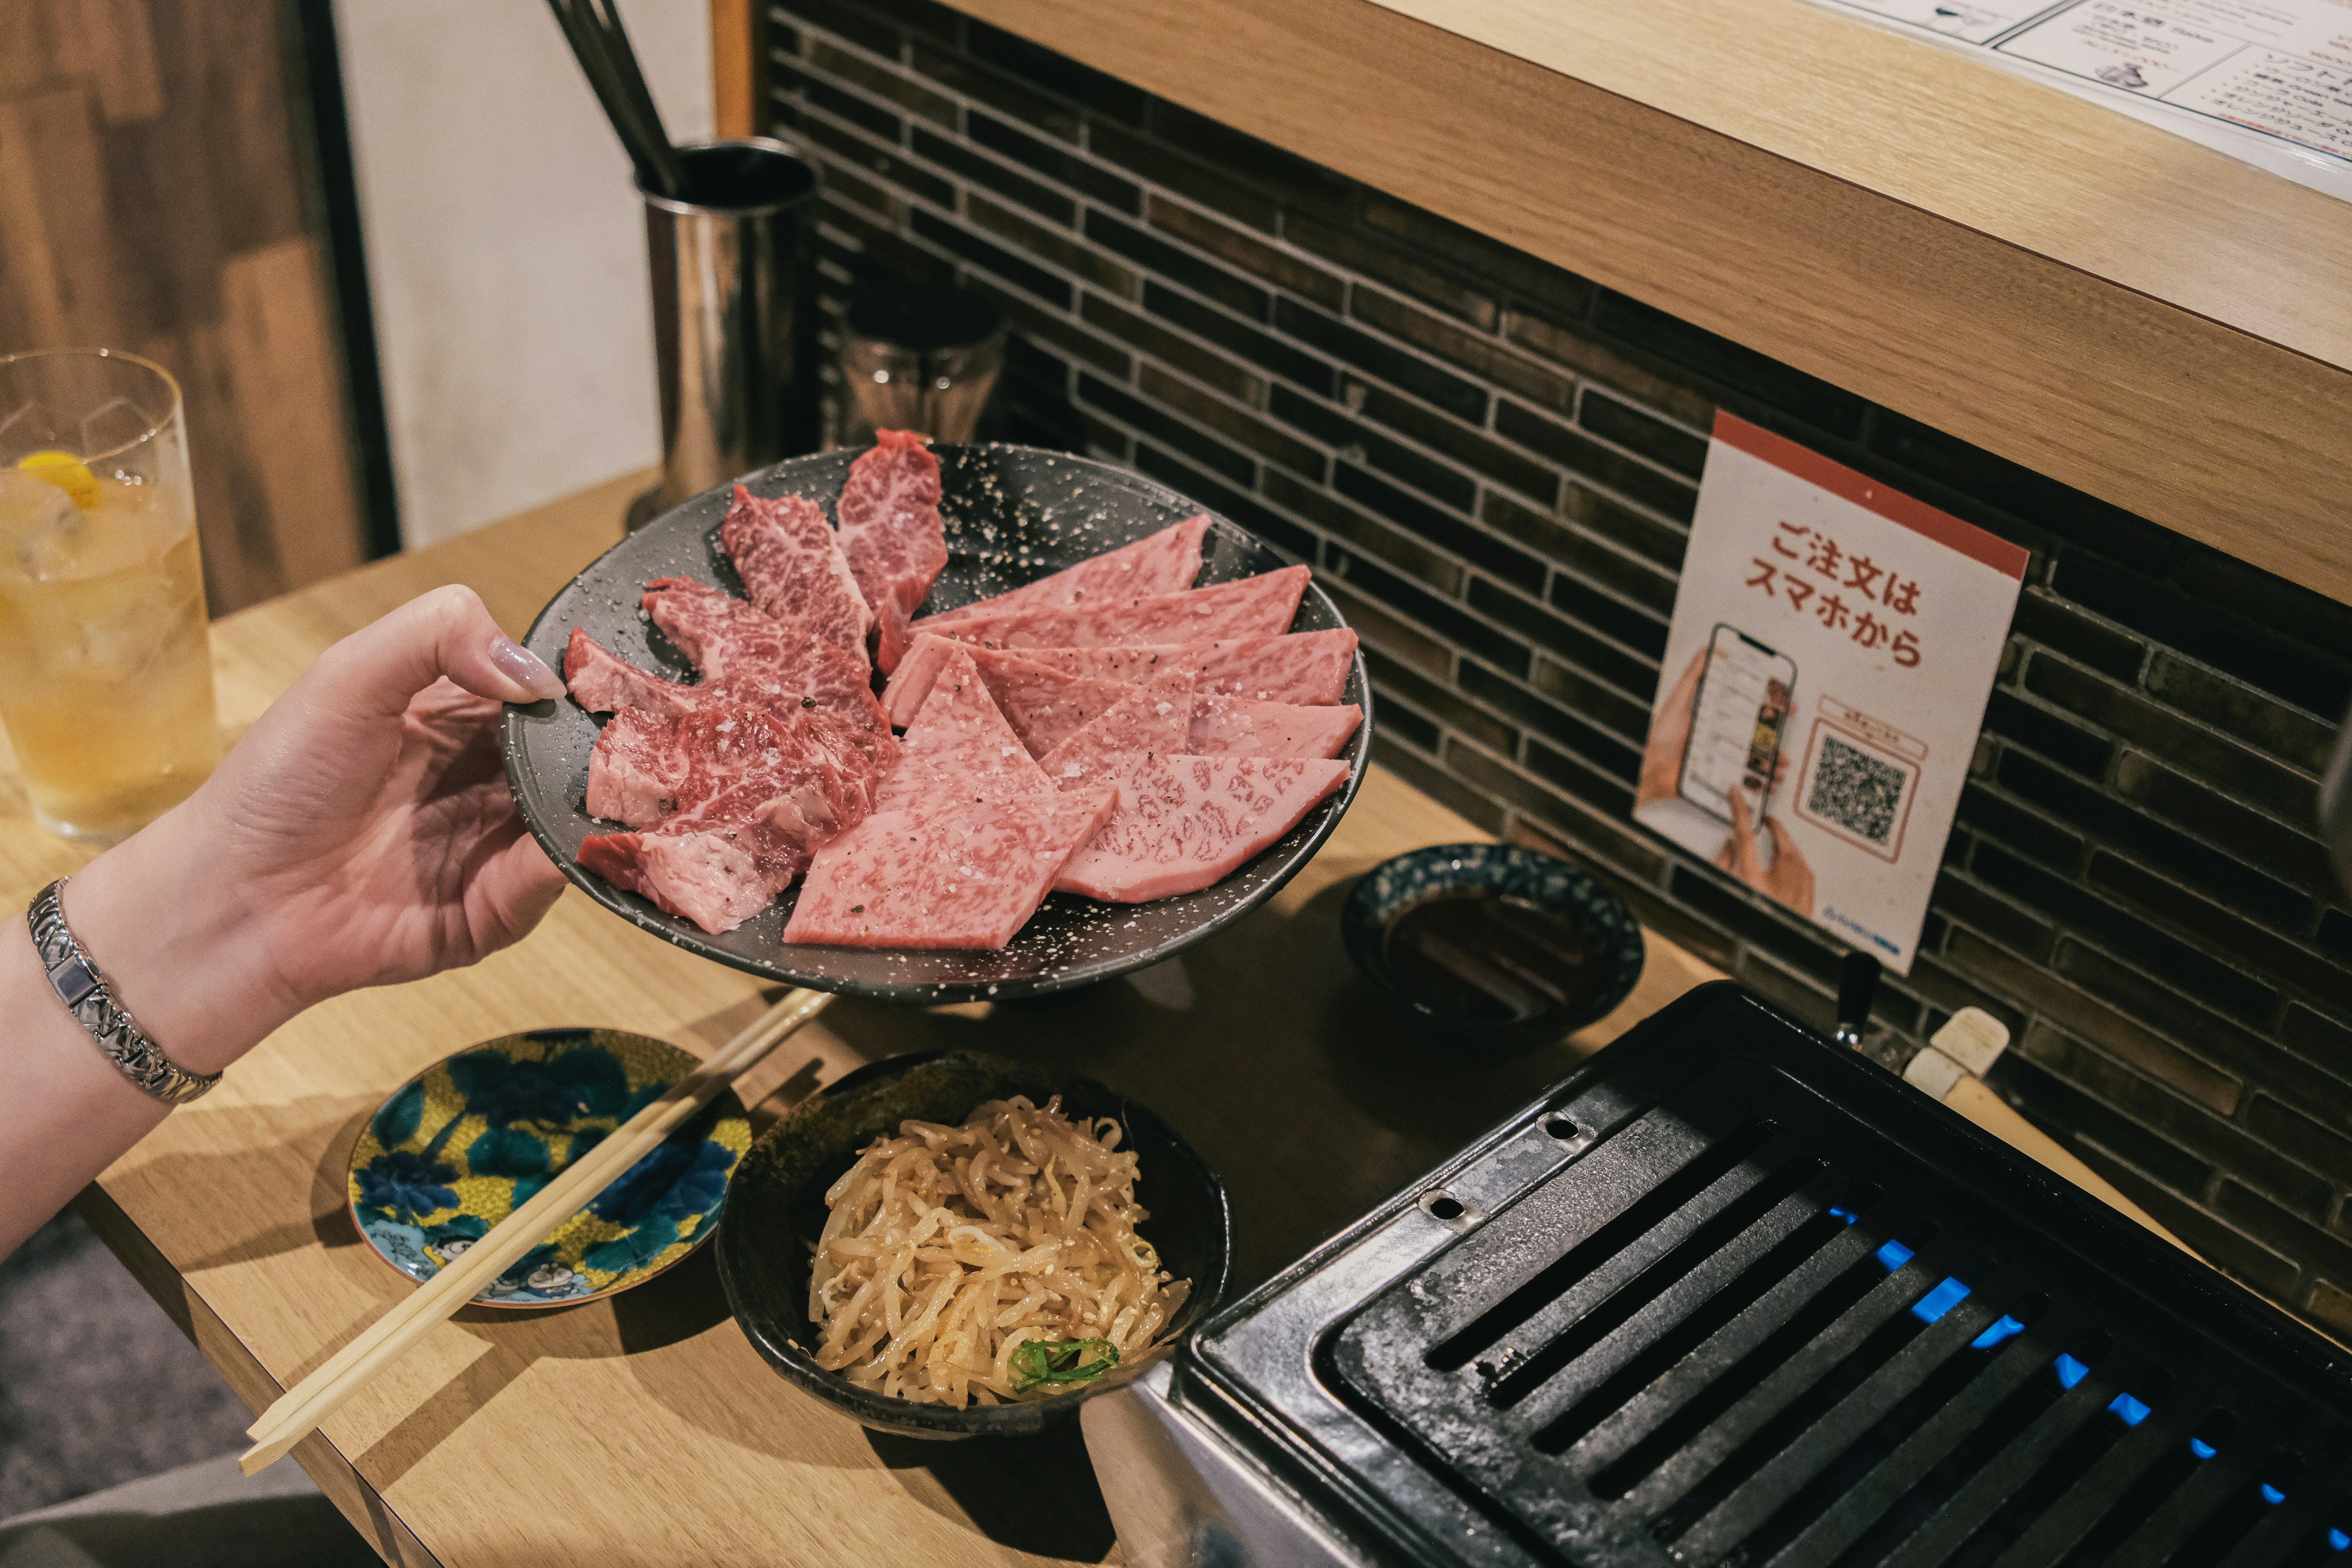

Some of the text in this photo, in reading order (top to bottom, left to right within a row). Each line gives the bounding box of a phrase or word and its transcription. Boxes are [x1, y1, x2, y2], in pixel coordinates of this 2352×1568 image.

[1746, 557, 1921, 668] スマホから
[1772, 521, 1921, 616] ご注文は
